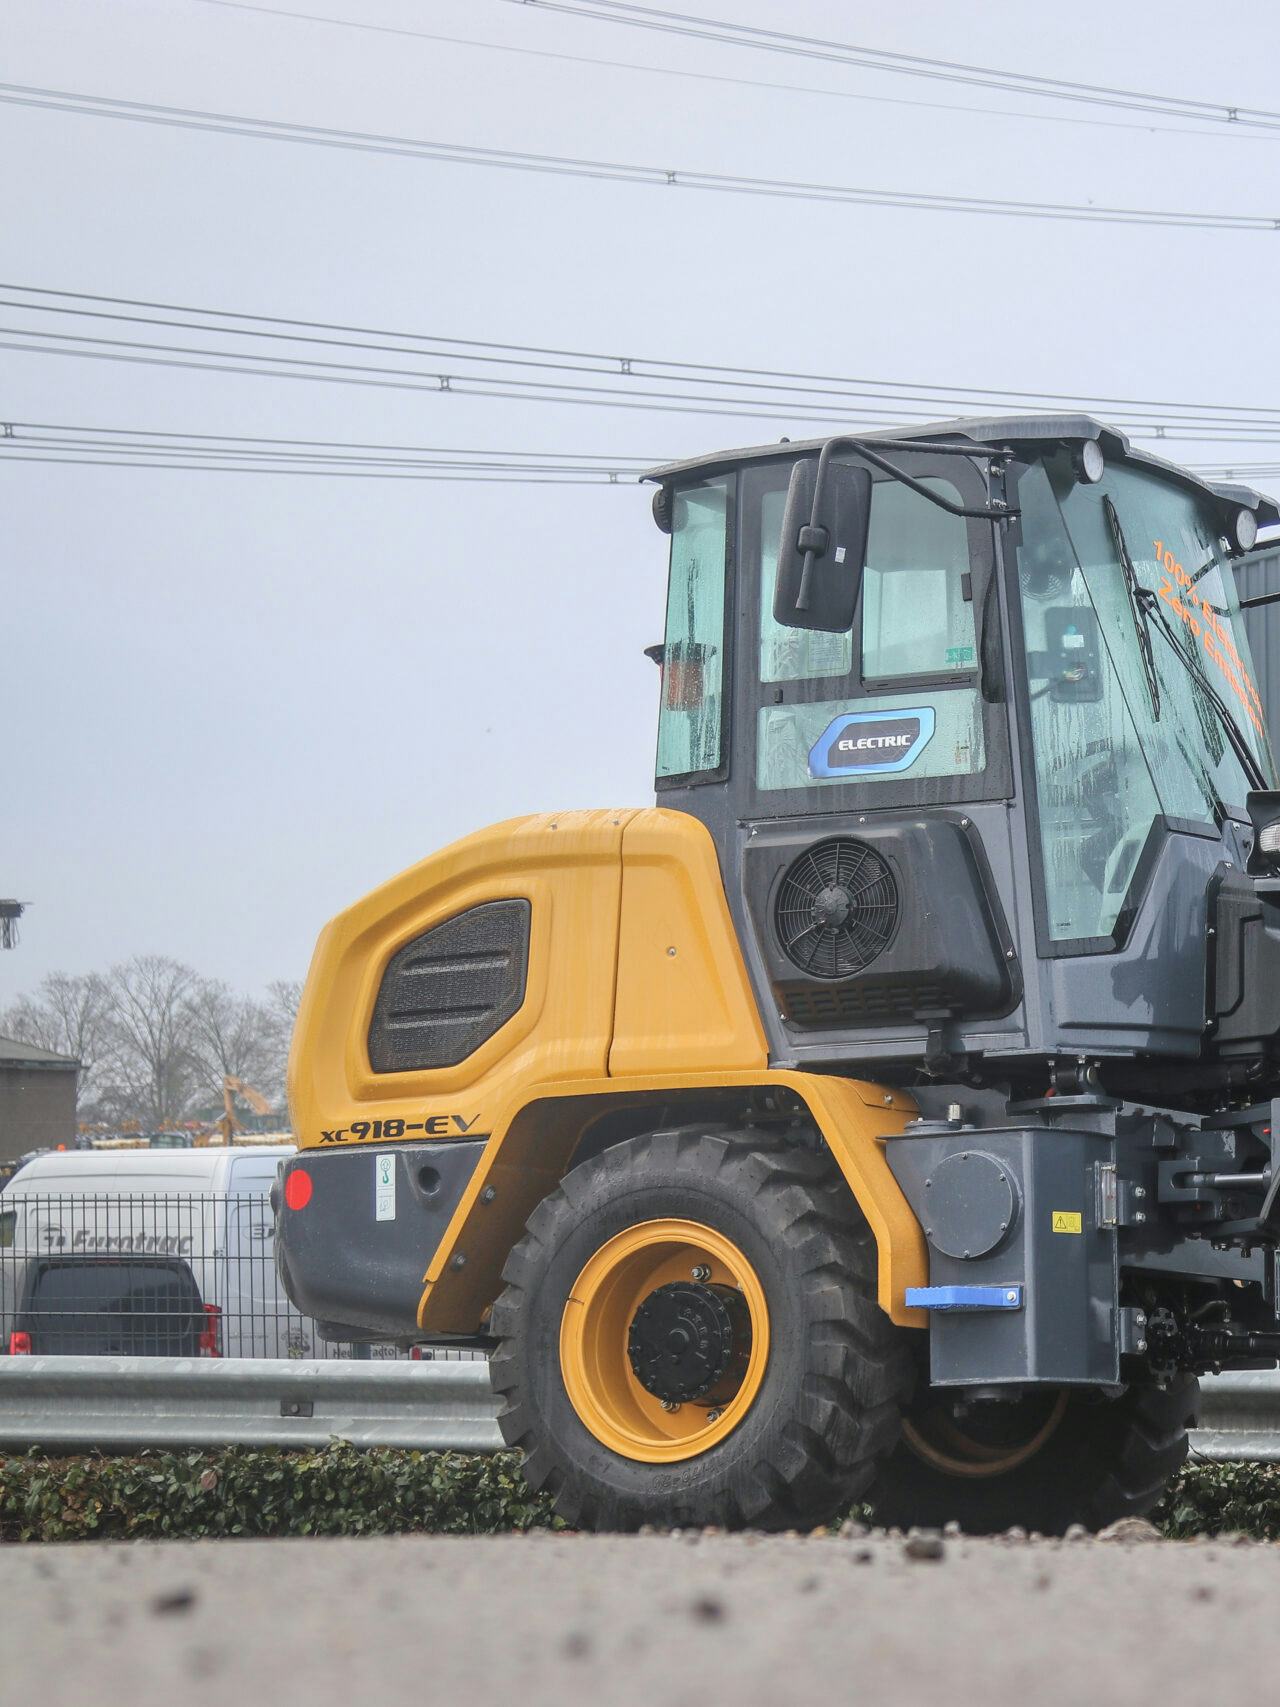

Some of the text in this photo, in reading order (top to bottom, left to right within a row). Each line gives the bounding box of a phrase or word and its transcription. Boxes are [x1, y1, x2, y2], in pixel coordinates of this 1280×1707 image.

[1157, 575, 1201, 637] Zero
[838, 734, 911, 751] ELECTRIC
[318, 1113, 481, 1144] XC918-EV
